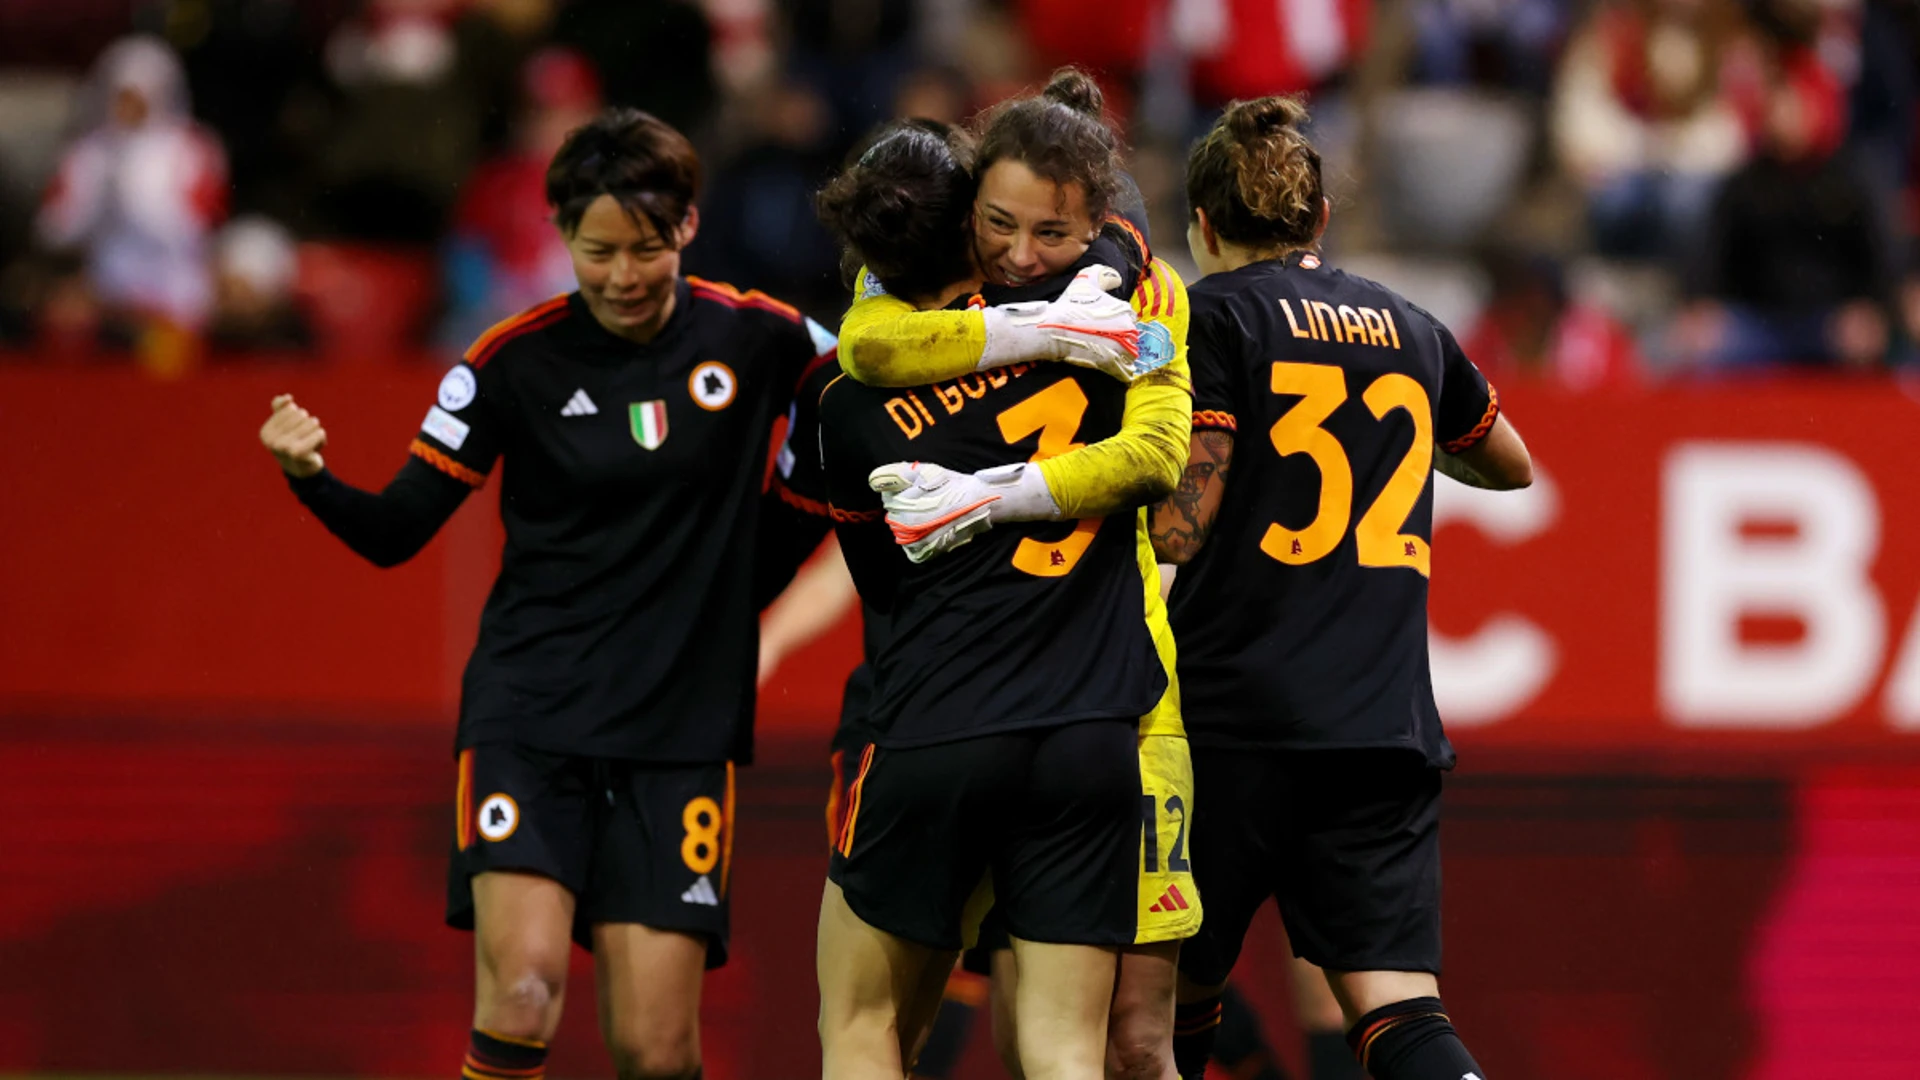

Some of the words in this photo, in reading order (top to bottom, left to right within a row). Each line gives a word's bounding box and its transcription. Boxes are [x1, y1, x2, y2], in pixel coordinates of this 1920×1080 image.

[1278, 298, 1400, 349] LINARI
[884, 389, 936, 441] DI
[996, 376, 1100, 577] 3
[1260, 361, 1434, 578] 32
[681, 797, 721, 874] 8
[1142, 794, 1191, 873] 12
